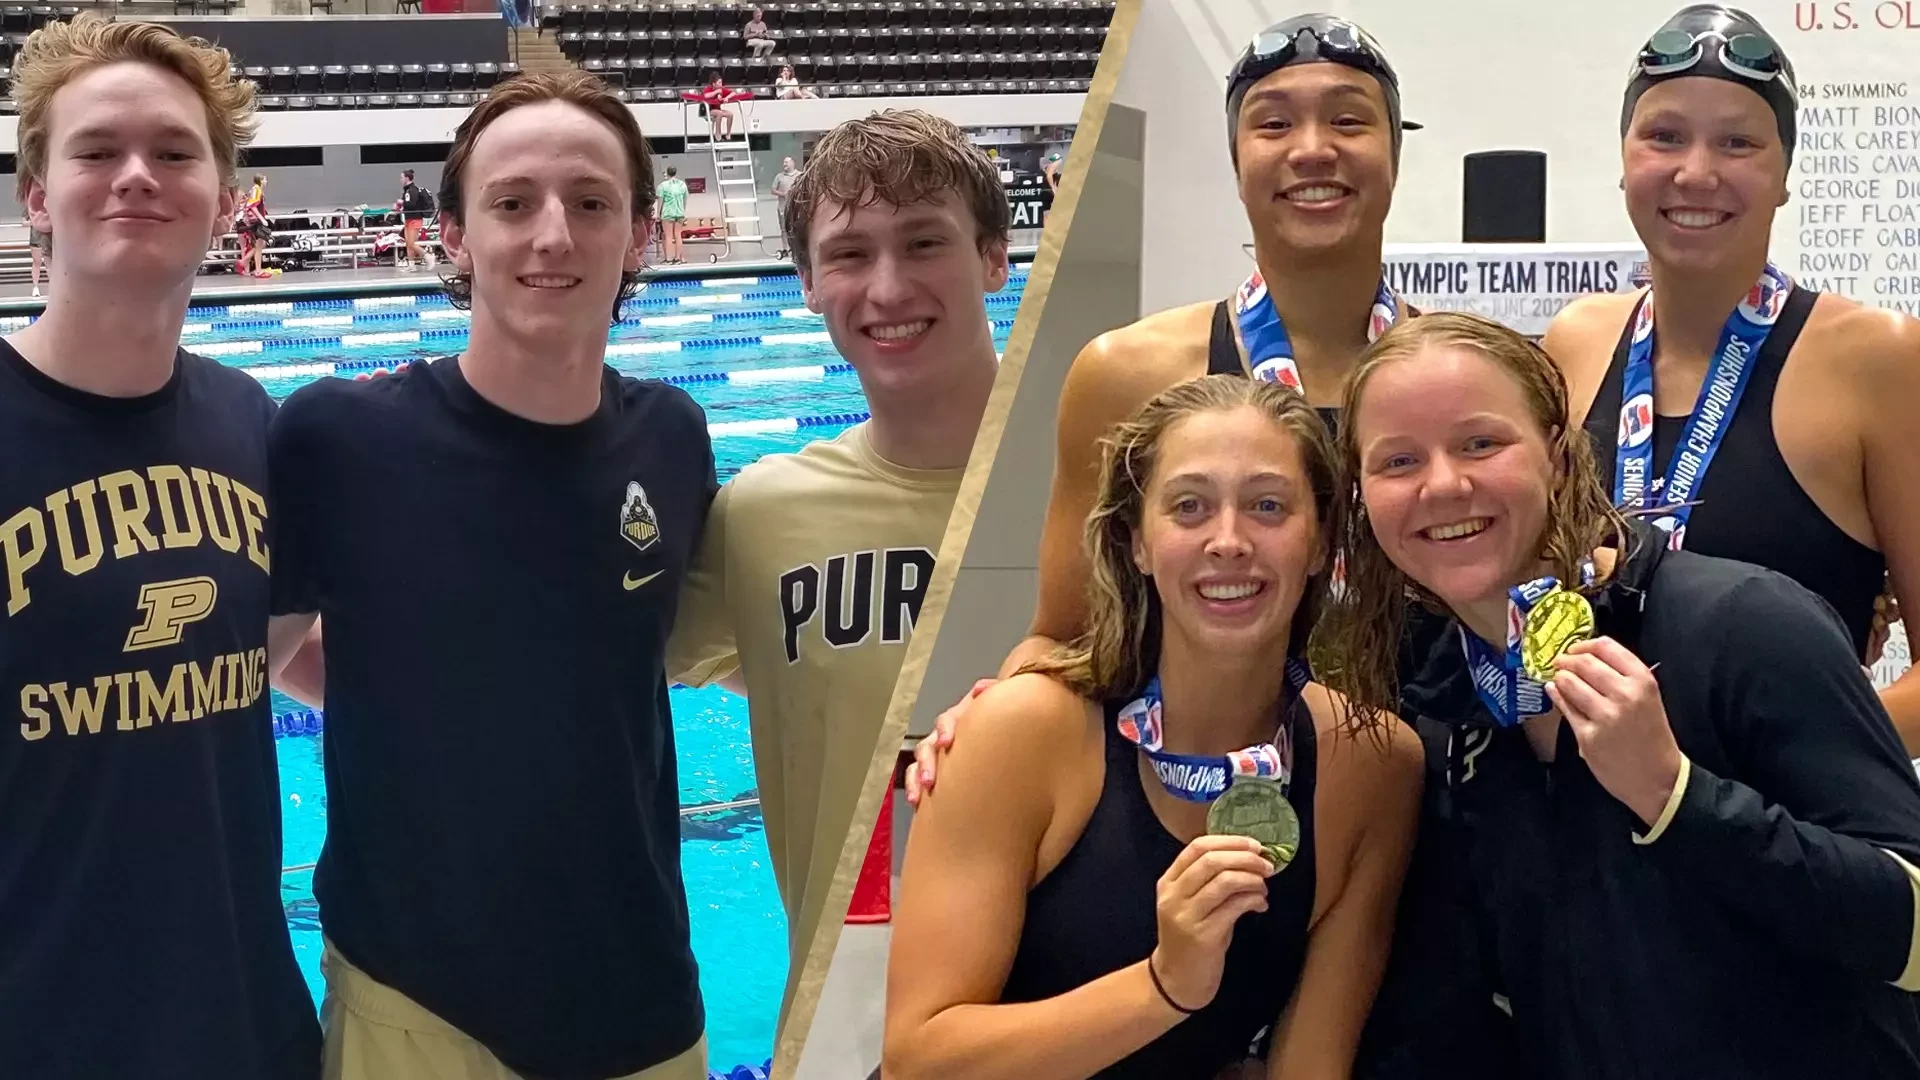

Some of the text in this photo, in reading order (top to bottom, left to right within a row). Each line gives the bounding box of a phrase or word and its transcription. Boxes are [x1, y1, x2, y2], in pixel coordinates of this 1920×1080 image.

[1822, 83, 1907, 98] SWIMMING
[1800, 107, 1860, 127] MATT
[1801, 131, 1920, 150] RICK CAREY
[1800, 154, 1920, 174] CHRIS CAVA
[1800, 180, 1920, 199] GEORGE DI
[1800, 205, 1847, 226] JEFF
[1800, 228, 1920, 247] GEOFF GAB
[1800, 253, 1872, 272] ROWDY
[1477, 262, 1536, 294] TEAM
[1545, 260, 1618, 293] TRIALS
[1801, 277, 1858, 295] MATT
[1492, 298, 1527, 317] JUNE
[1532, 298, 1570, 317] 202
[1667, 334, 1751, 504] SENIOR CHAMPIONSHIPS
[624, 521, 656, 540] PURDUE
[0, 465, 270, 617] PURDUE
[123, 576, 217, 652] P
[779, 547, 936, 666] PUR
[21, 647, 266, 741] SWIMMING
